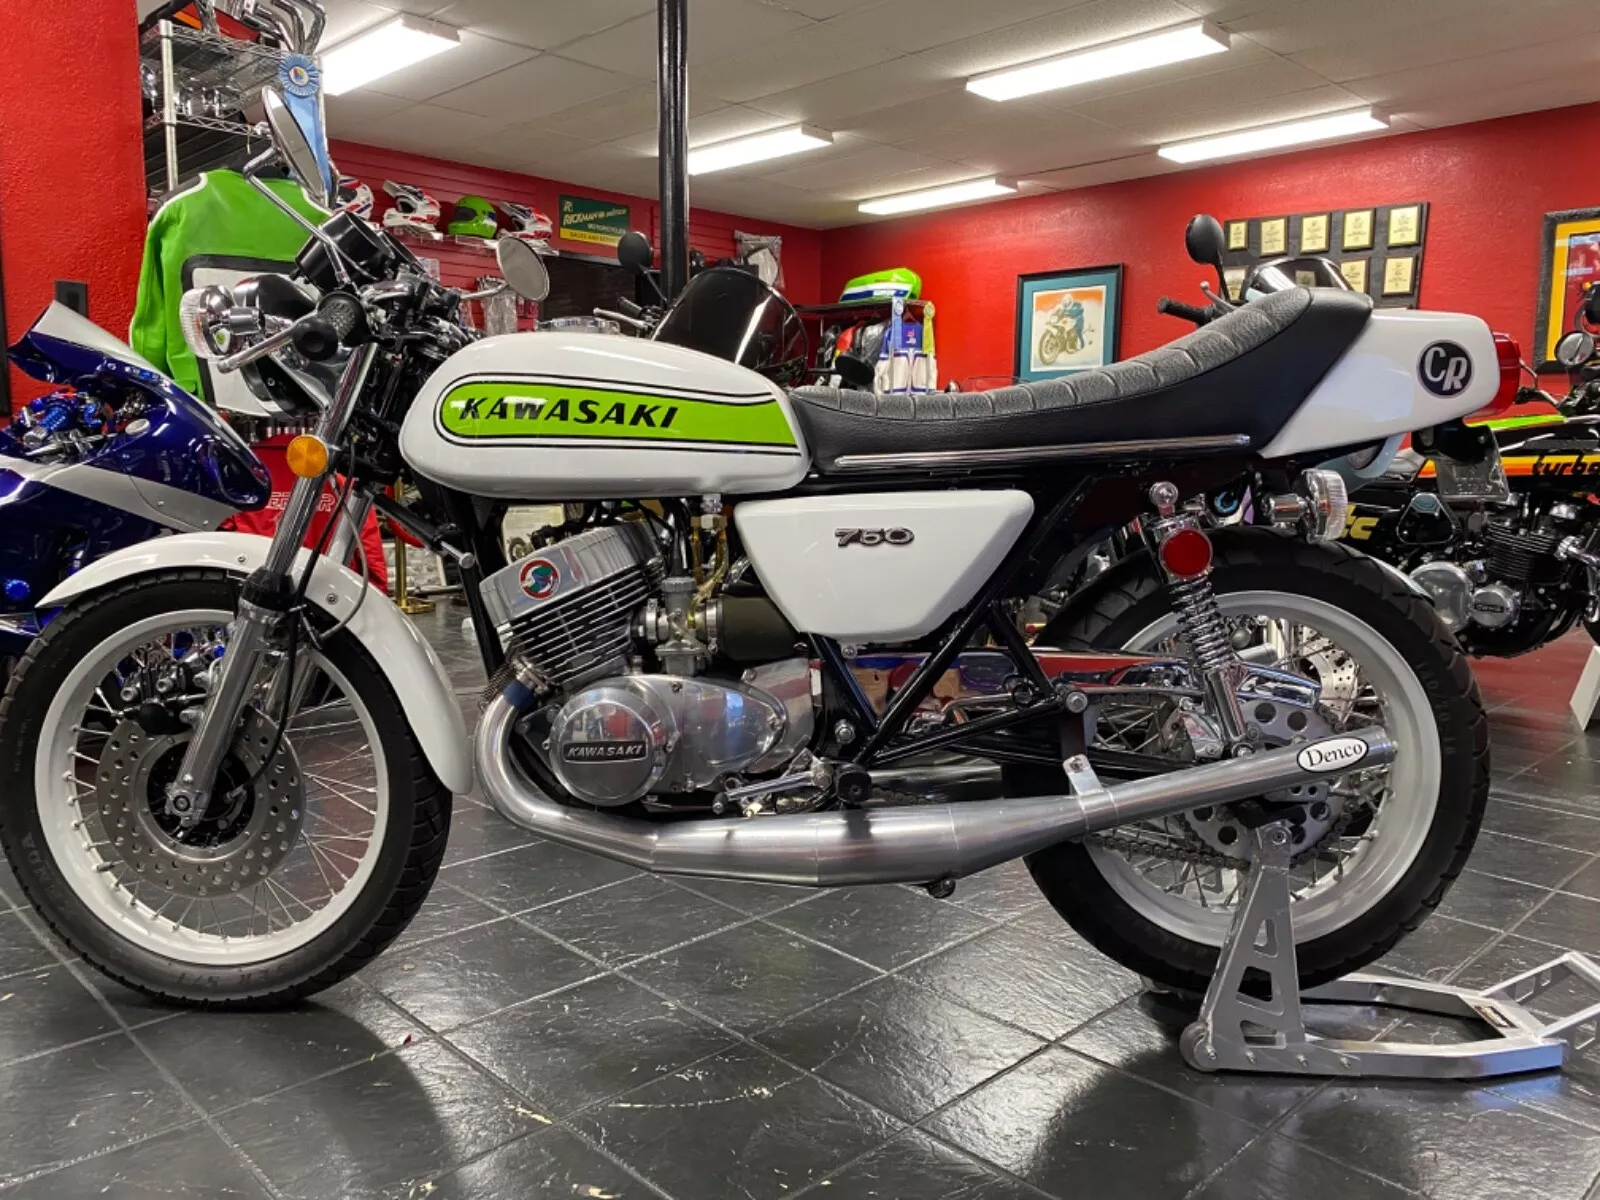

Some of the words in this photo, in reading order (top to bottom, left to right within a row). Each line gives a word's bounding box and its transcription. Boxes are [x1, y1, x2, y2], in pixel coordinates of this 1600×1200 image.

[458, 397, 679, 429] KAWASAKI
[834, 526, 915, 548] 750
[567, 744, 644, 758] KAWASAKI
[1305, 743, 1363, 767] Denco
